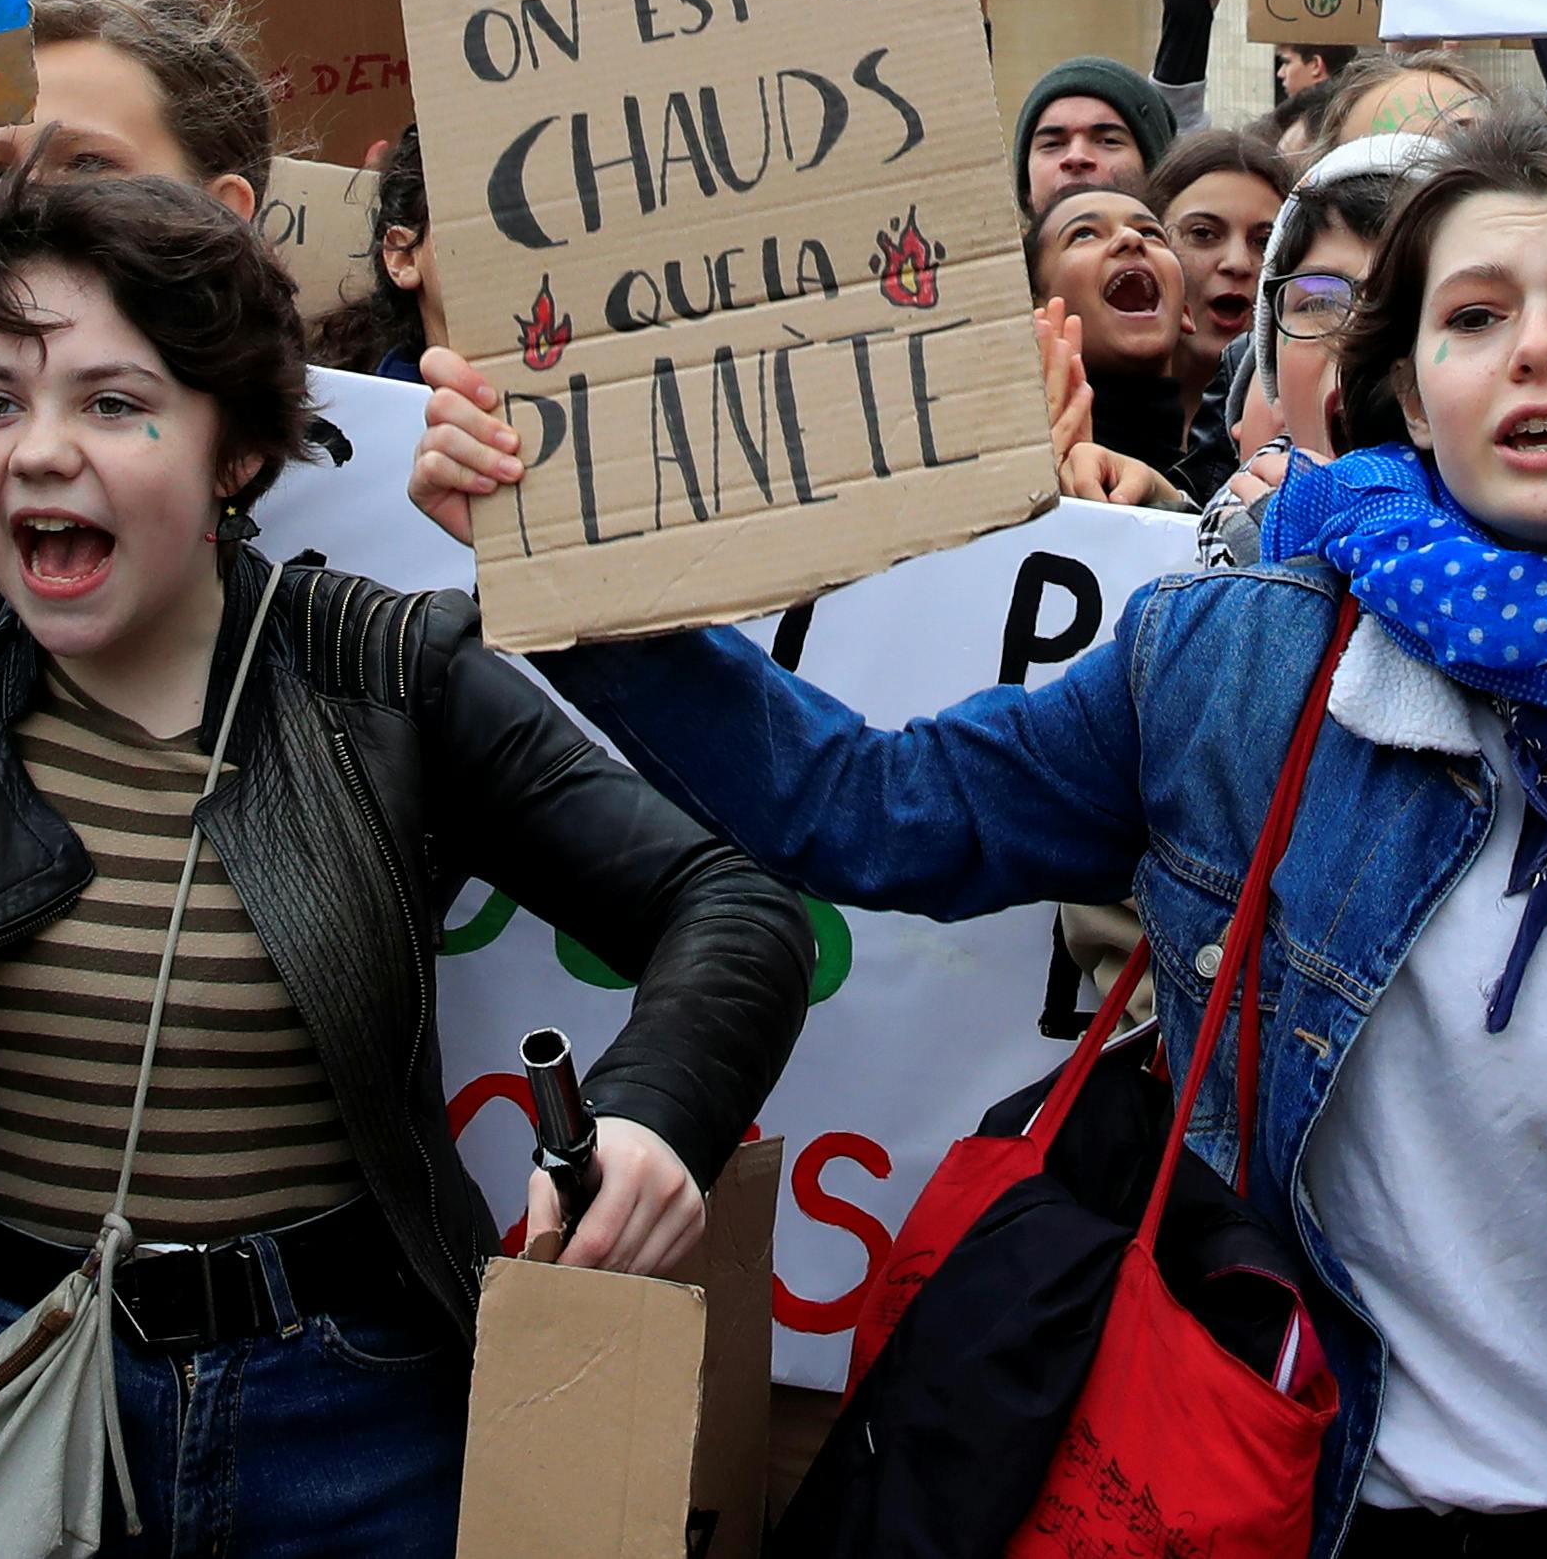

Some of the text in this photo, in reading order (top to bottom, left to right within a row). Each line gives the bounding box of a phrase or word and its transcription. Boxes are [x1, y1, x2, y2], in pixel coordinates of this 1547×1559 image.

[486, 47, 926, 250] CHAUDS
[604, 235, 840, 335] QUE LA
[504, 318, 980, 559] PLANÈTE
